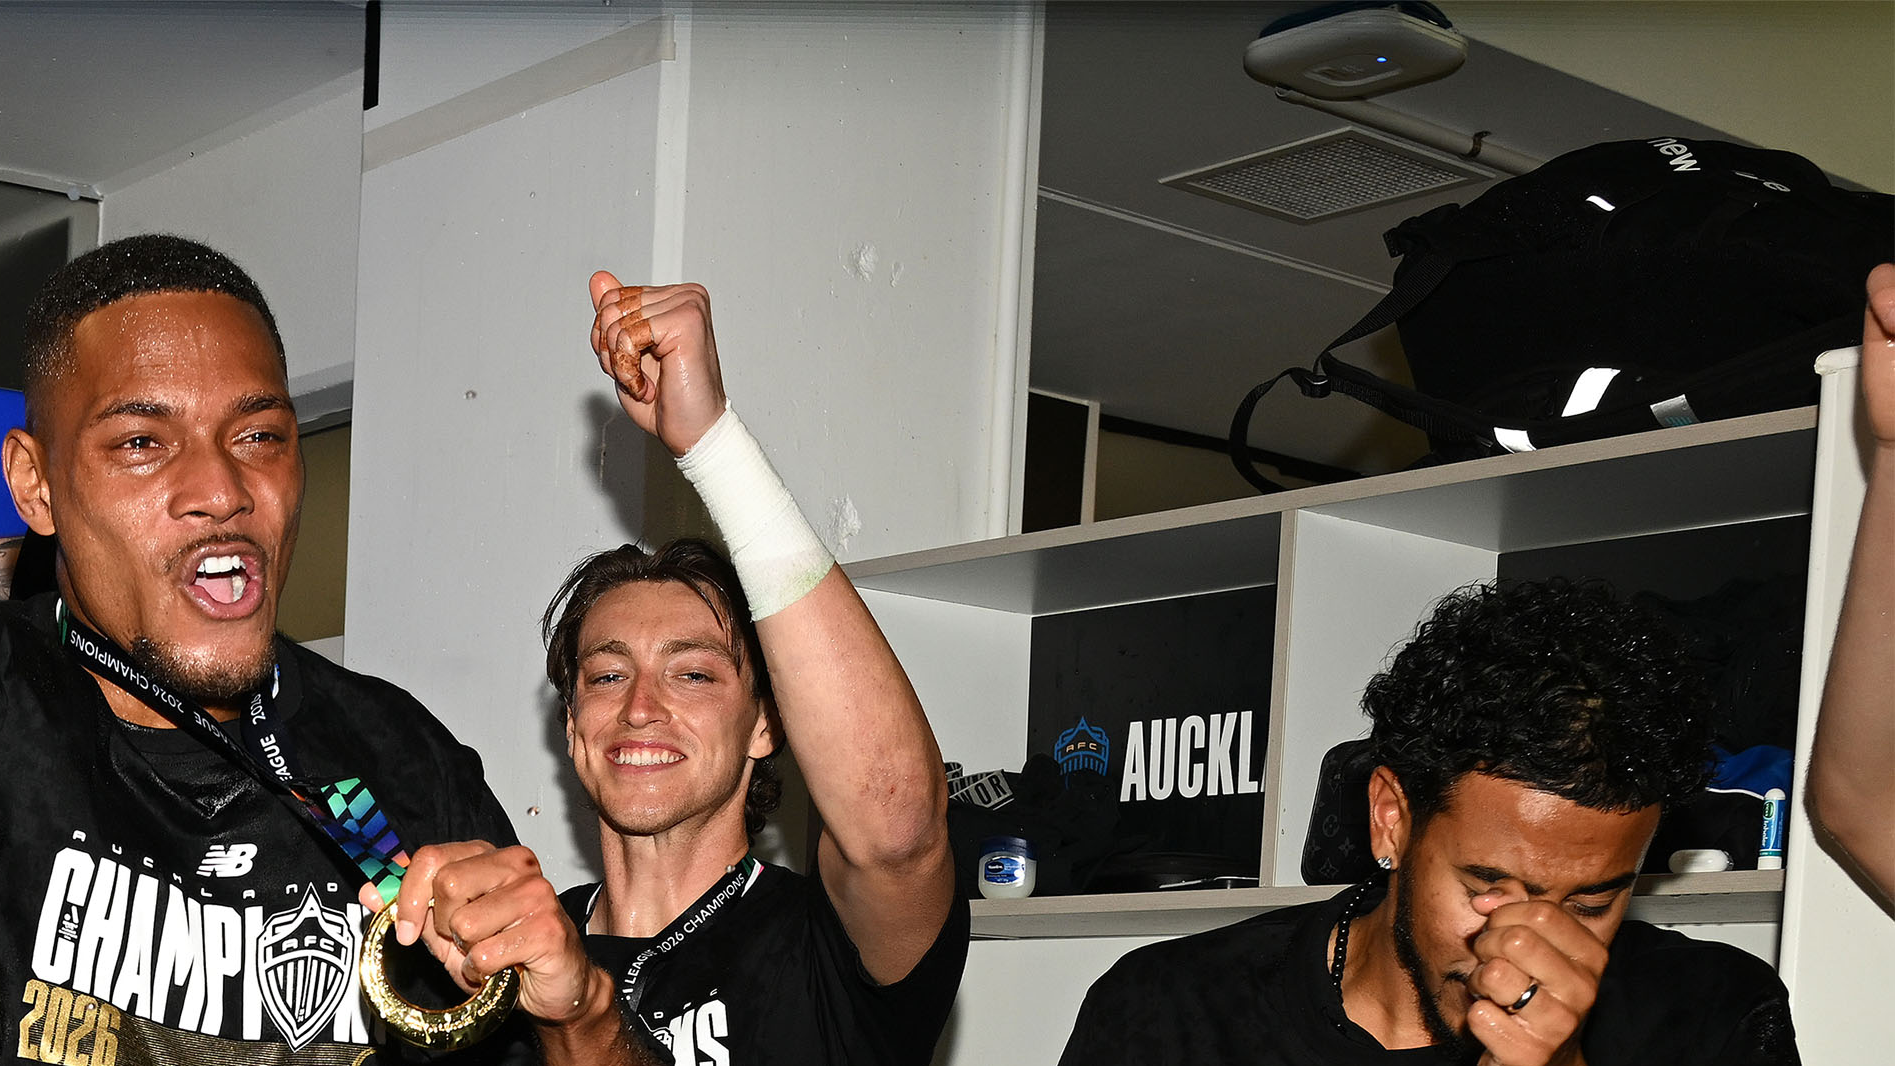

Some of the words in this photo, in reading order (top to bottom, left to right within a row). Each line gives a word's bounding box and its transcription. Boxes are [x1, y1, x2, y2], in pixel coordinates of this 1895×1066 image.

[1647, 138, 1701, 171] new
[69, 630, 149, 690] CHAMPIONS
[152, 683, 185, 713] 2026
[1066, 741, 1098, 753] AFC
[1119, 710, 1269, 803] AUCKL
[683, 873, 745, 934] CHAMPIONS
[282, 935, 335, 951] AFC
